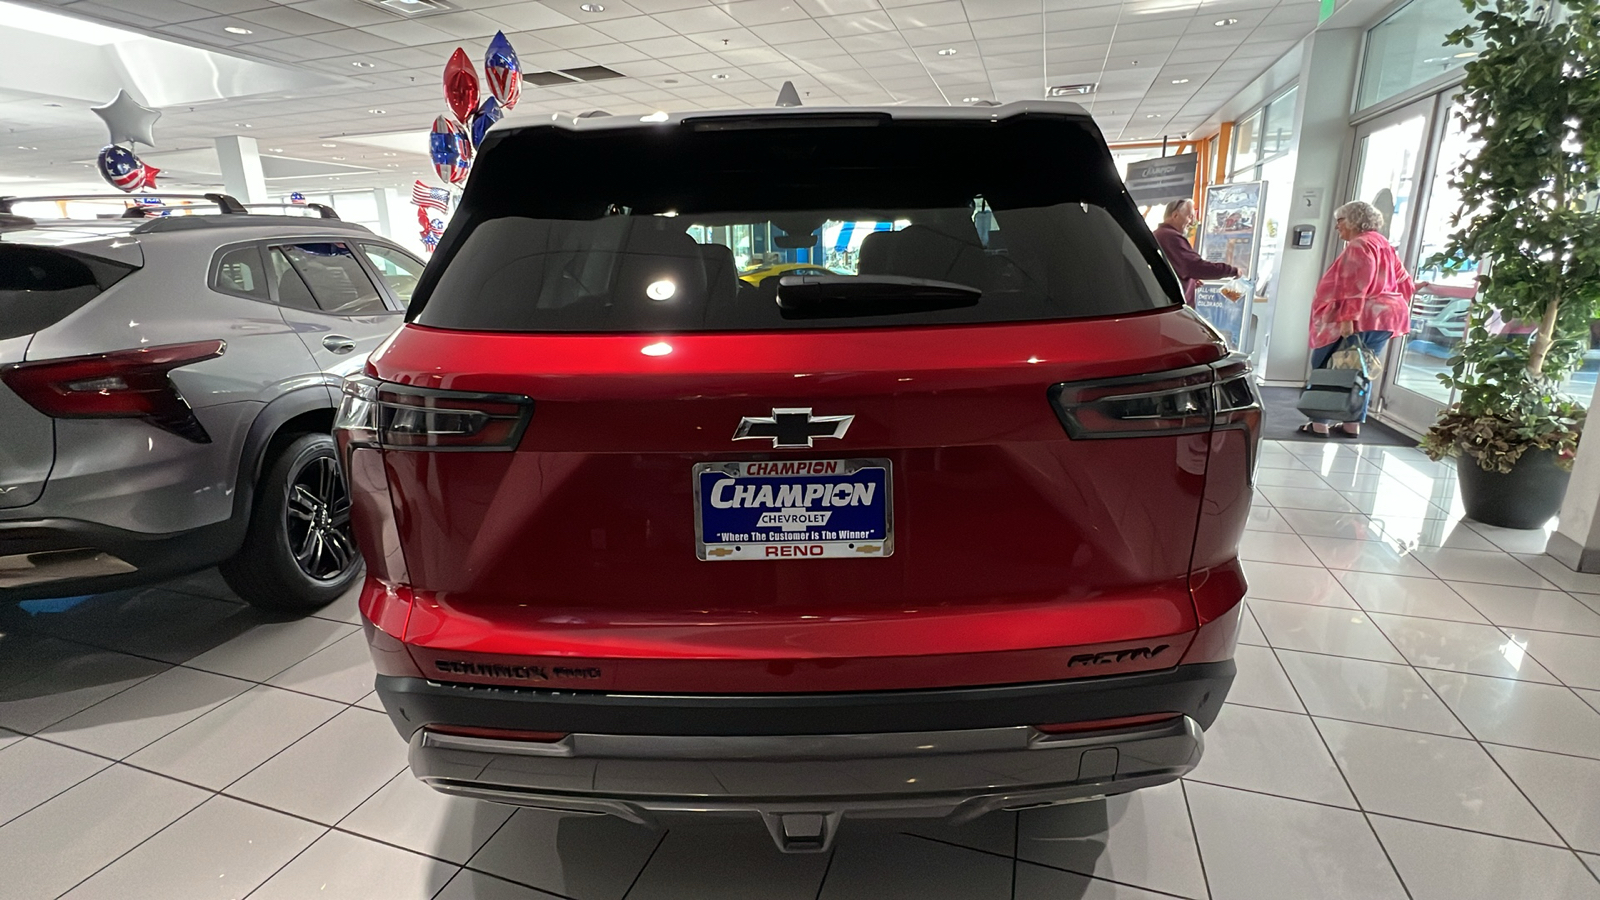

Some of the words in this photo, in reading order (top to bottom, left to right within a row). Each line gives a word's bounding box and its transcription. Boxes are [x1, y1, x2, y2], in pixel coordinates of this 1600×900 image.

[746, 461, 838, 476] CHAMPION
[710, 478, 876, 509] CHAMPION
[761, 513, 826, 524] CHEVROLET
[716, 532, 749, 542] "Where
[751, 531, 767, 541] The
[769, 531, 809, 541] Customer
[811, 531, 820, 540] Is
[822, 530, 837, 540] The
[839, 529, 875, 539] Winner"
[765, 544, 824, 557] RENO
